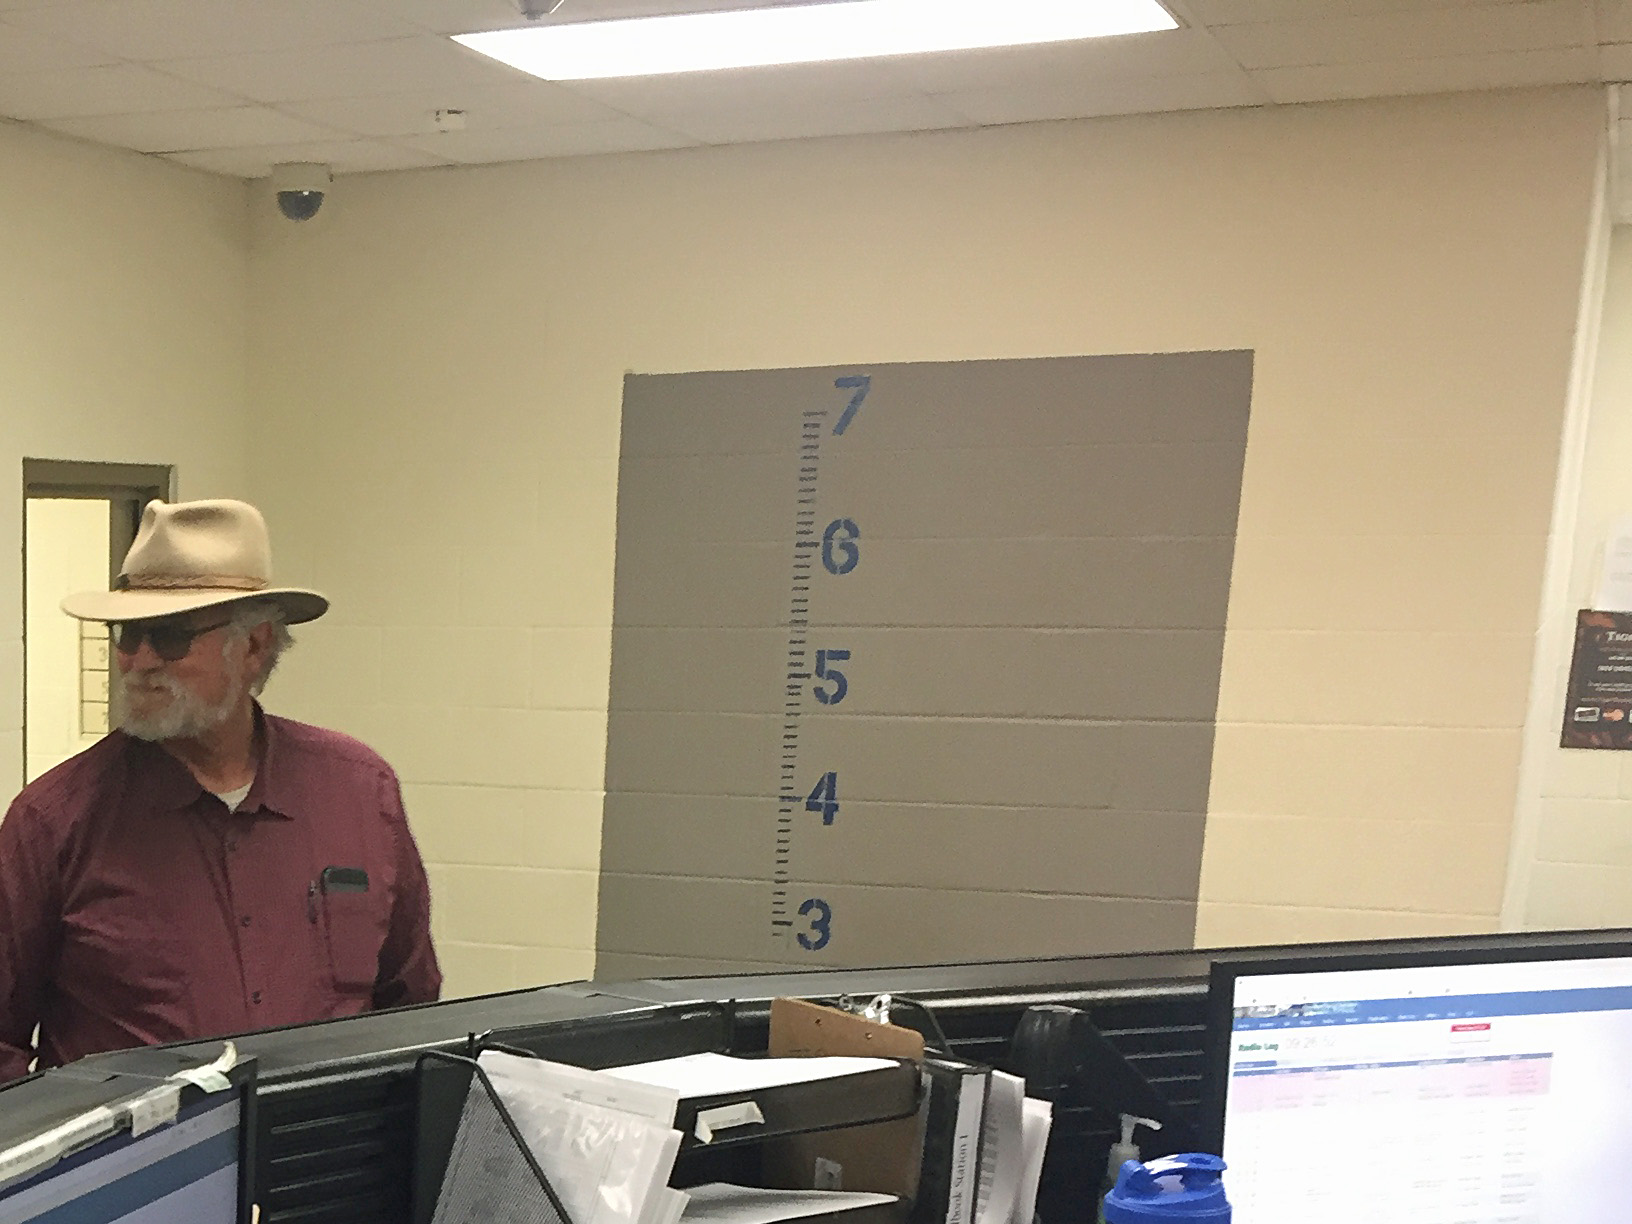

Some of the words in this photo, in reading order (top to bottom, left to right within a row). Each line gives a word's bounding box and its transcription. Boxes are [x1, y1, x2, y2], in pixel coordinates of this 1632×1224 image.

[833, 376, 870, 436] 7
[821, 518, 860, 574] 6
[813, 650, 850, 705] 5
[805, 772, 840, 825] 4
[796, 899, 832, 950] 3
